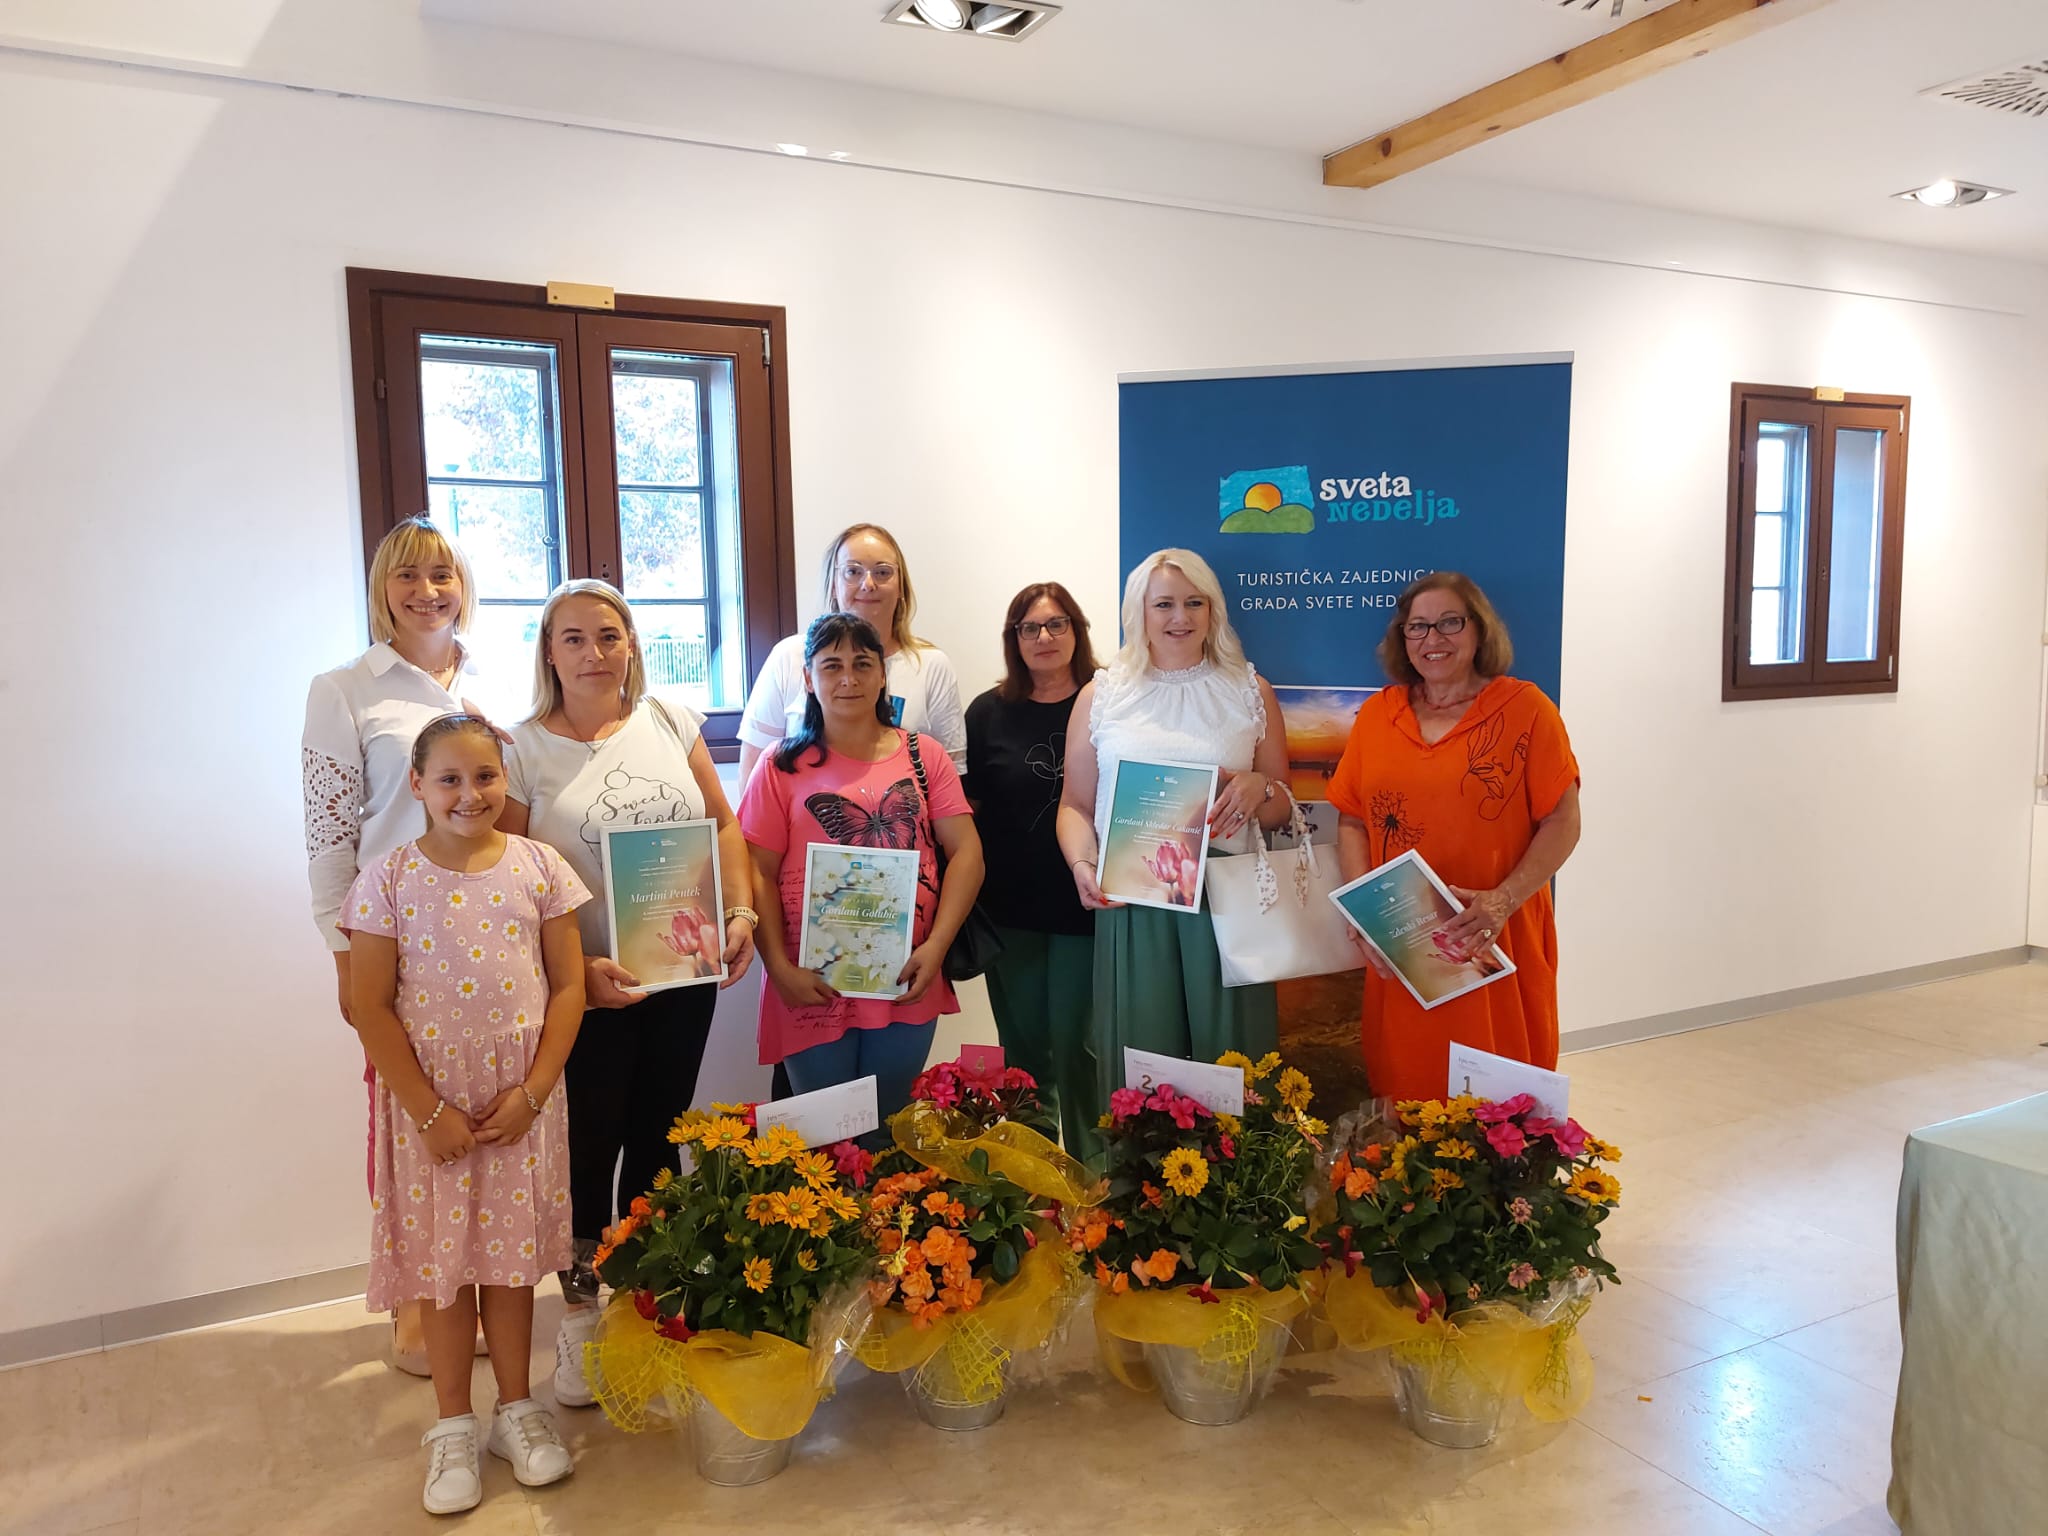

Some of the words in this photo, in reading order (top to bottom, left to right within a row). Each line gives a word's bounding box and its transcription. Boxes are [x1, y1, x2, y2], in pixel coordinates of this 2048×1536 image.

[1319, 471, 1412, 501] sveta
[1237, 568, 1334, 586] TURISTIČKA
[1240, 596, 1299, 611] GRADA
[1305, 595, 1354, 610] SVETE
[1361, 594, 1402, 609] NED
[601, 782, 673, 822] Sweet
[630, 889, 668, 905] Martini
[1141, 1074, 1152, 1091] 2
[1462, 1075, 1473, 1095] 1
